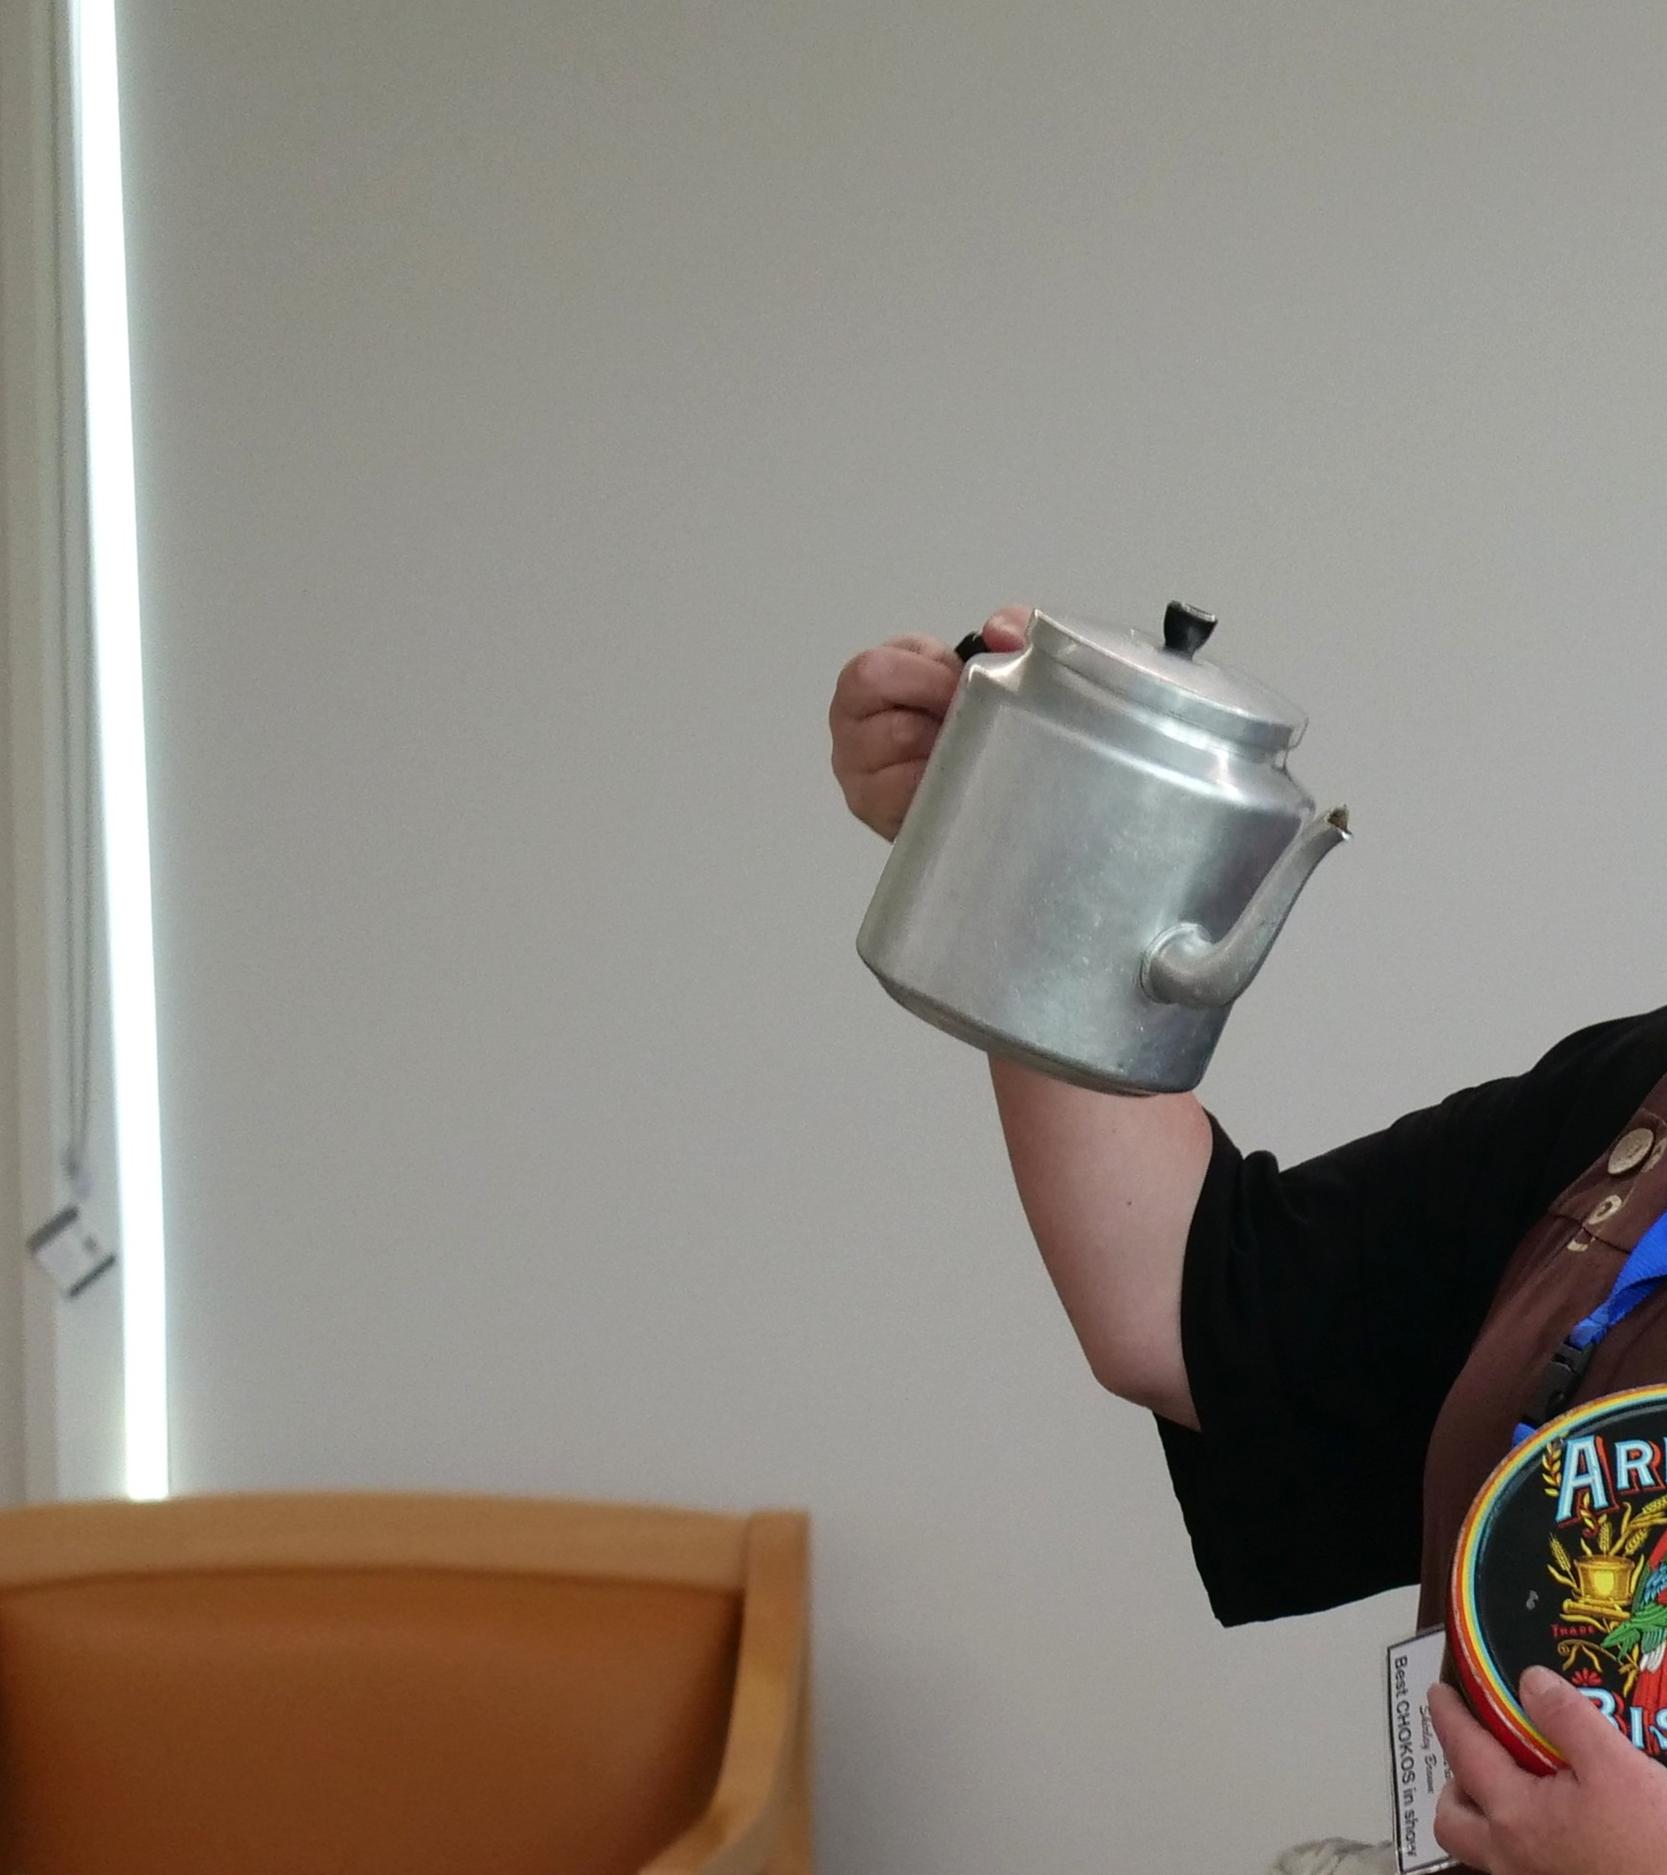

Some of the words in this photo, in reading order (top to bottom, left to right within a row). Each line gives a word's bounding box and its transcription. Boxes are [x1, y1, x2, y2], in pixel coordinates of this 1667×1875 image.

[1394, 1655, 1408, 1700] Best
[1396, 1700, 1416, 1785] CHOKOS
[1403, 1786, 1415, 1805] in
[1404, 1806, 1418, 1857] show
